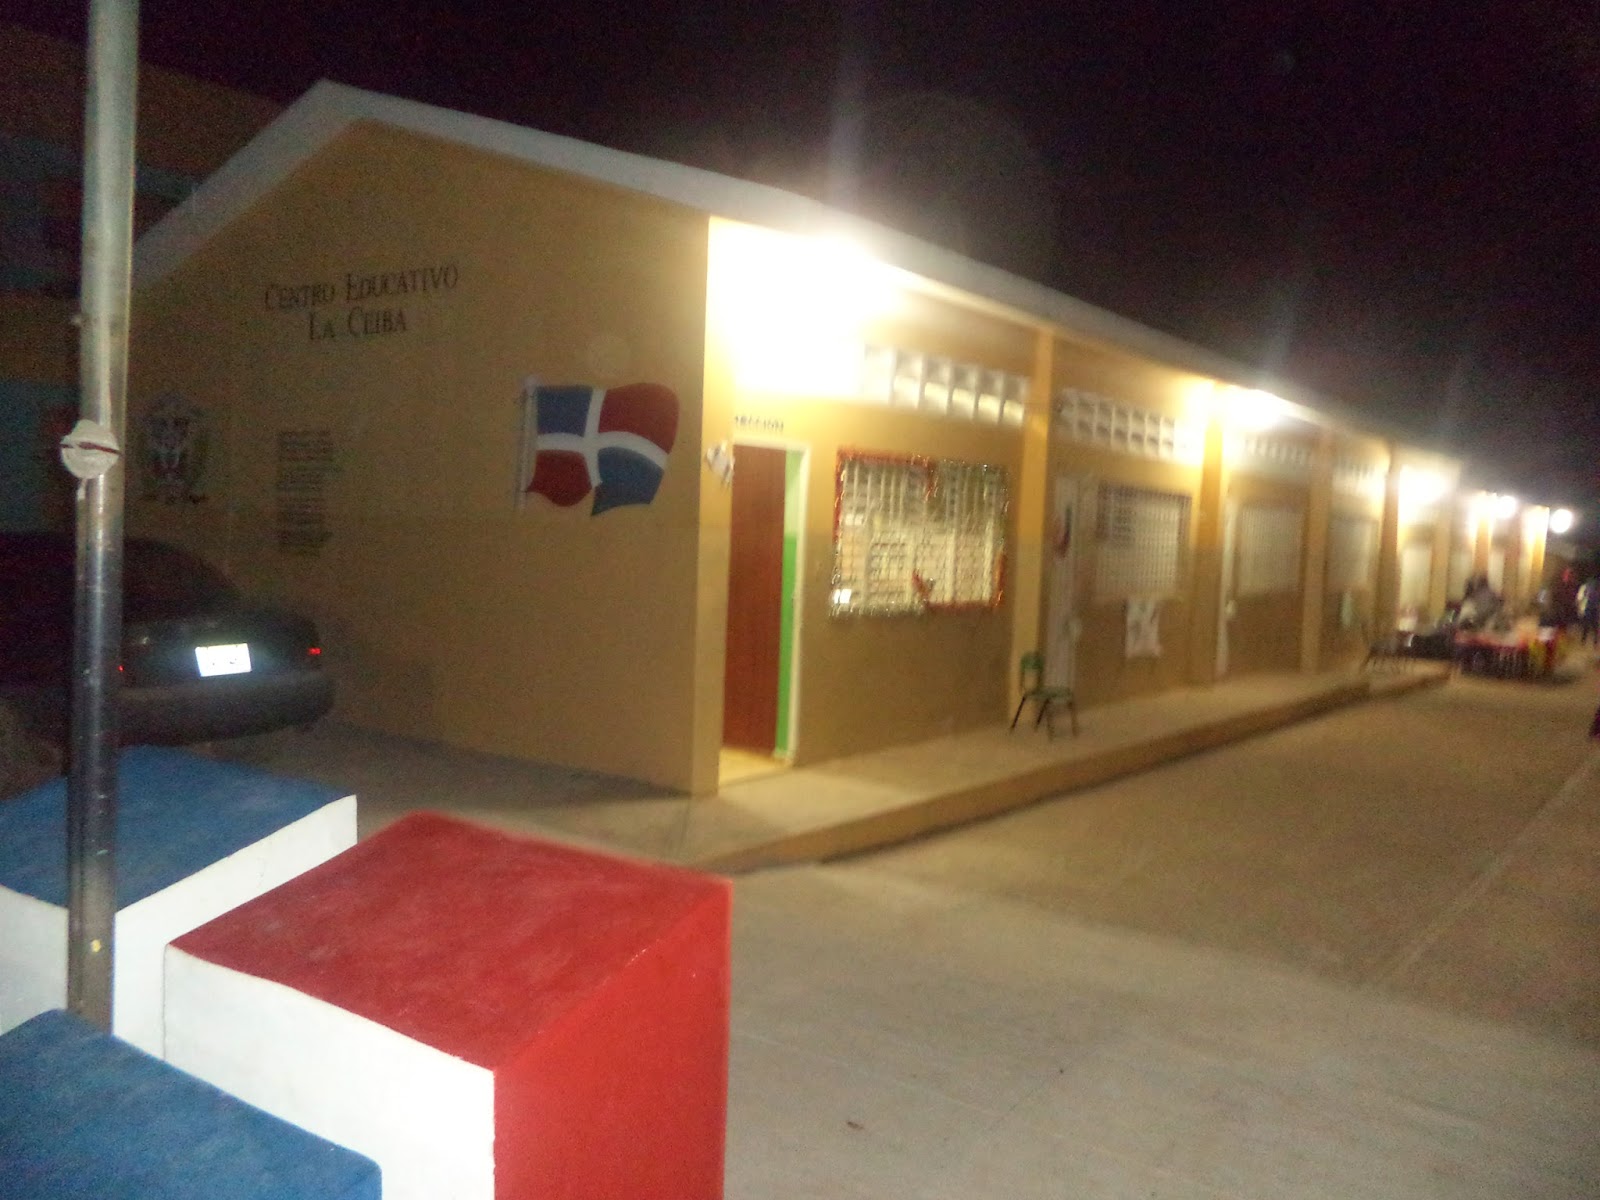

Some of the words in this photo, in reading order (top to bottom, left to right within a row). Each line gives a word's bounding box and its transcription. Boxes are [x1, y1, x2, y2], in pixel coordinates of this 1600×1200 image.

[264, 283, 335, 311] CENTRO
[346, 264, 459, 300] EDUCATIVO
[310, 313, 335, 340] LA
[348, 306, 407, 336] CEIBA
